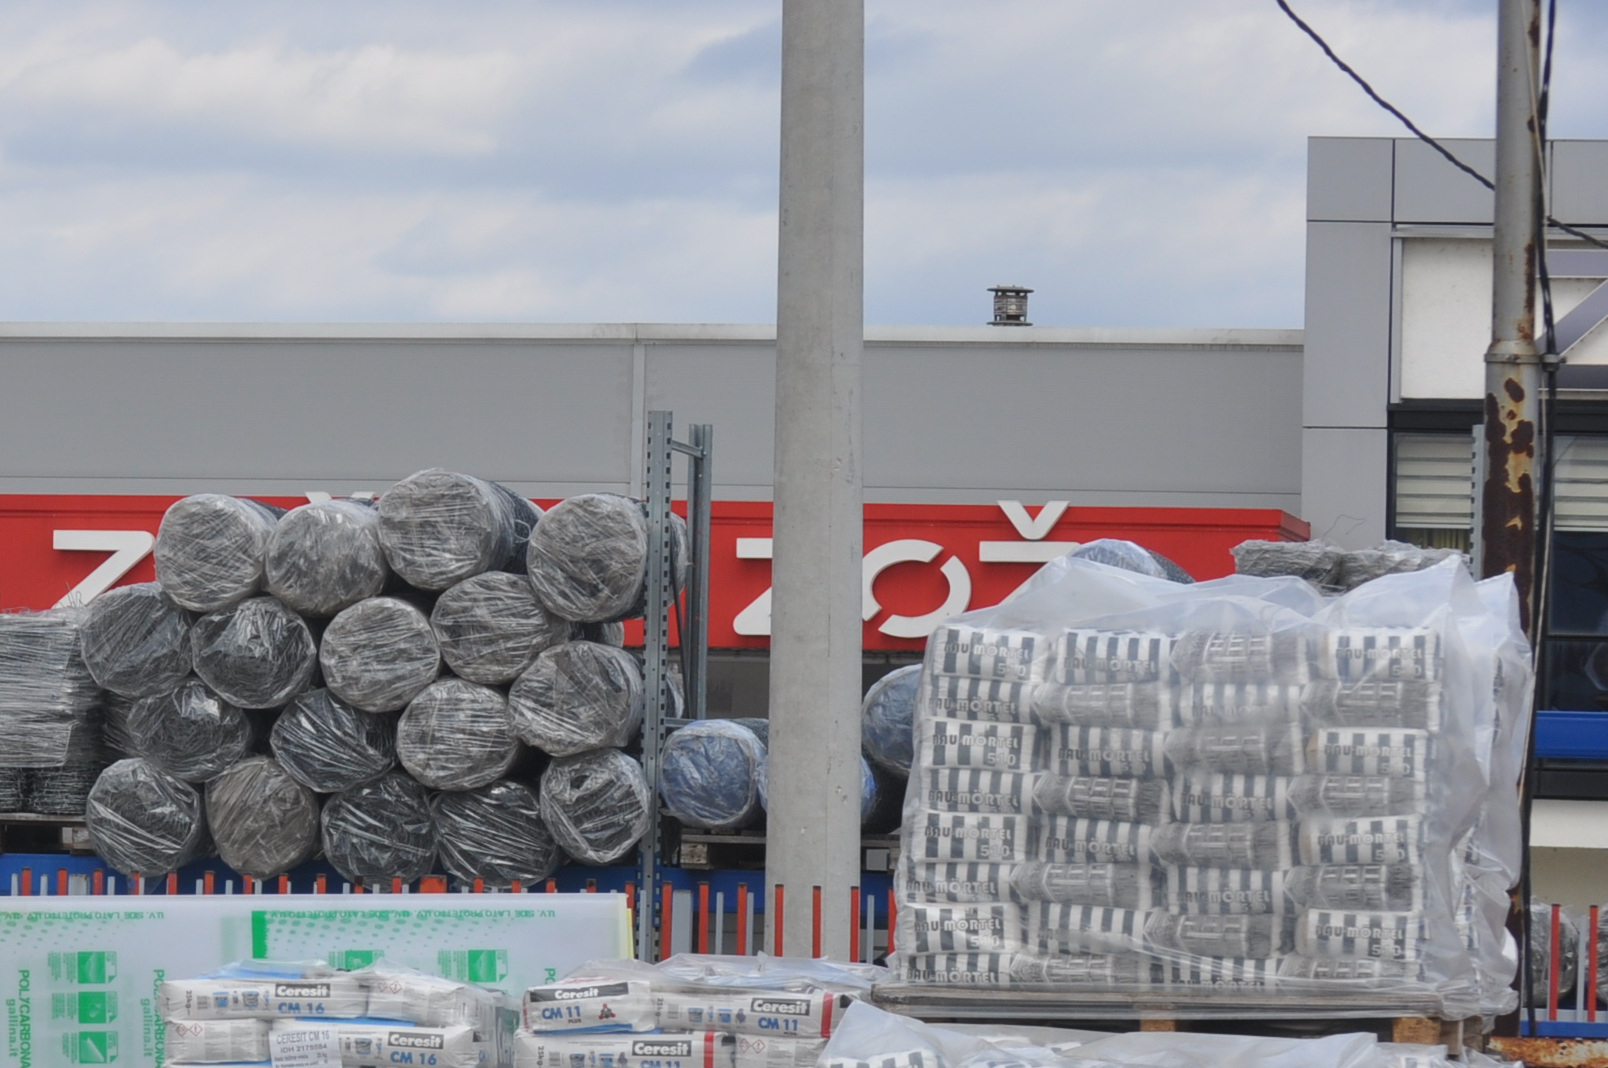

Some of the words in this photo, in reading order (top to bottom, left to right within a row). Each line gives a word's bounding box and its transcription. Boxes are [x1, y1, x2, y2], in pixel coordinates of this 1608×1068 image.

[277, 985, 328, 997] Ceresit
[554, 988, 599, 999] Ceresit
[278, 1002, 305, 1013] CM
[308, 1003, 324, 1014] 16
[542, 1006, 563, 1019] CM
[566, 1006, 580, 1018] 11
[752, 1000, 808, 1014] Ceresit
[758, 1018, 781, 1030] CM
[783, 1019, 798, 1031] 11
[277, 1032, 307, 1044] CERESIT
[309, 1031, 320, 1041] CM
[390, 1034, 441, 1047] Ceresit
[634, 1042, 689, 1055] Ceresit
[390, 1052, 418, 1064] CM
[420, 1053, 436, 1065] 16
